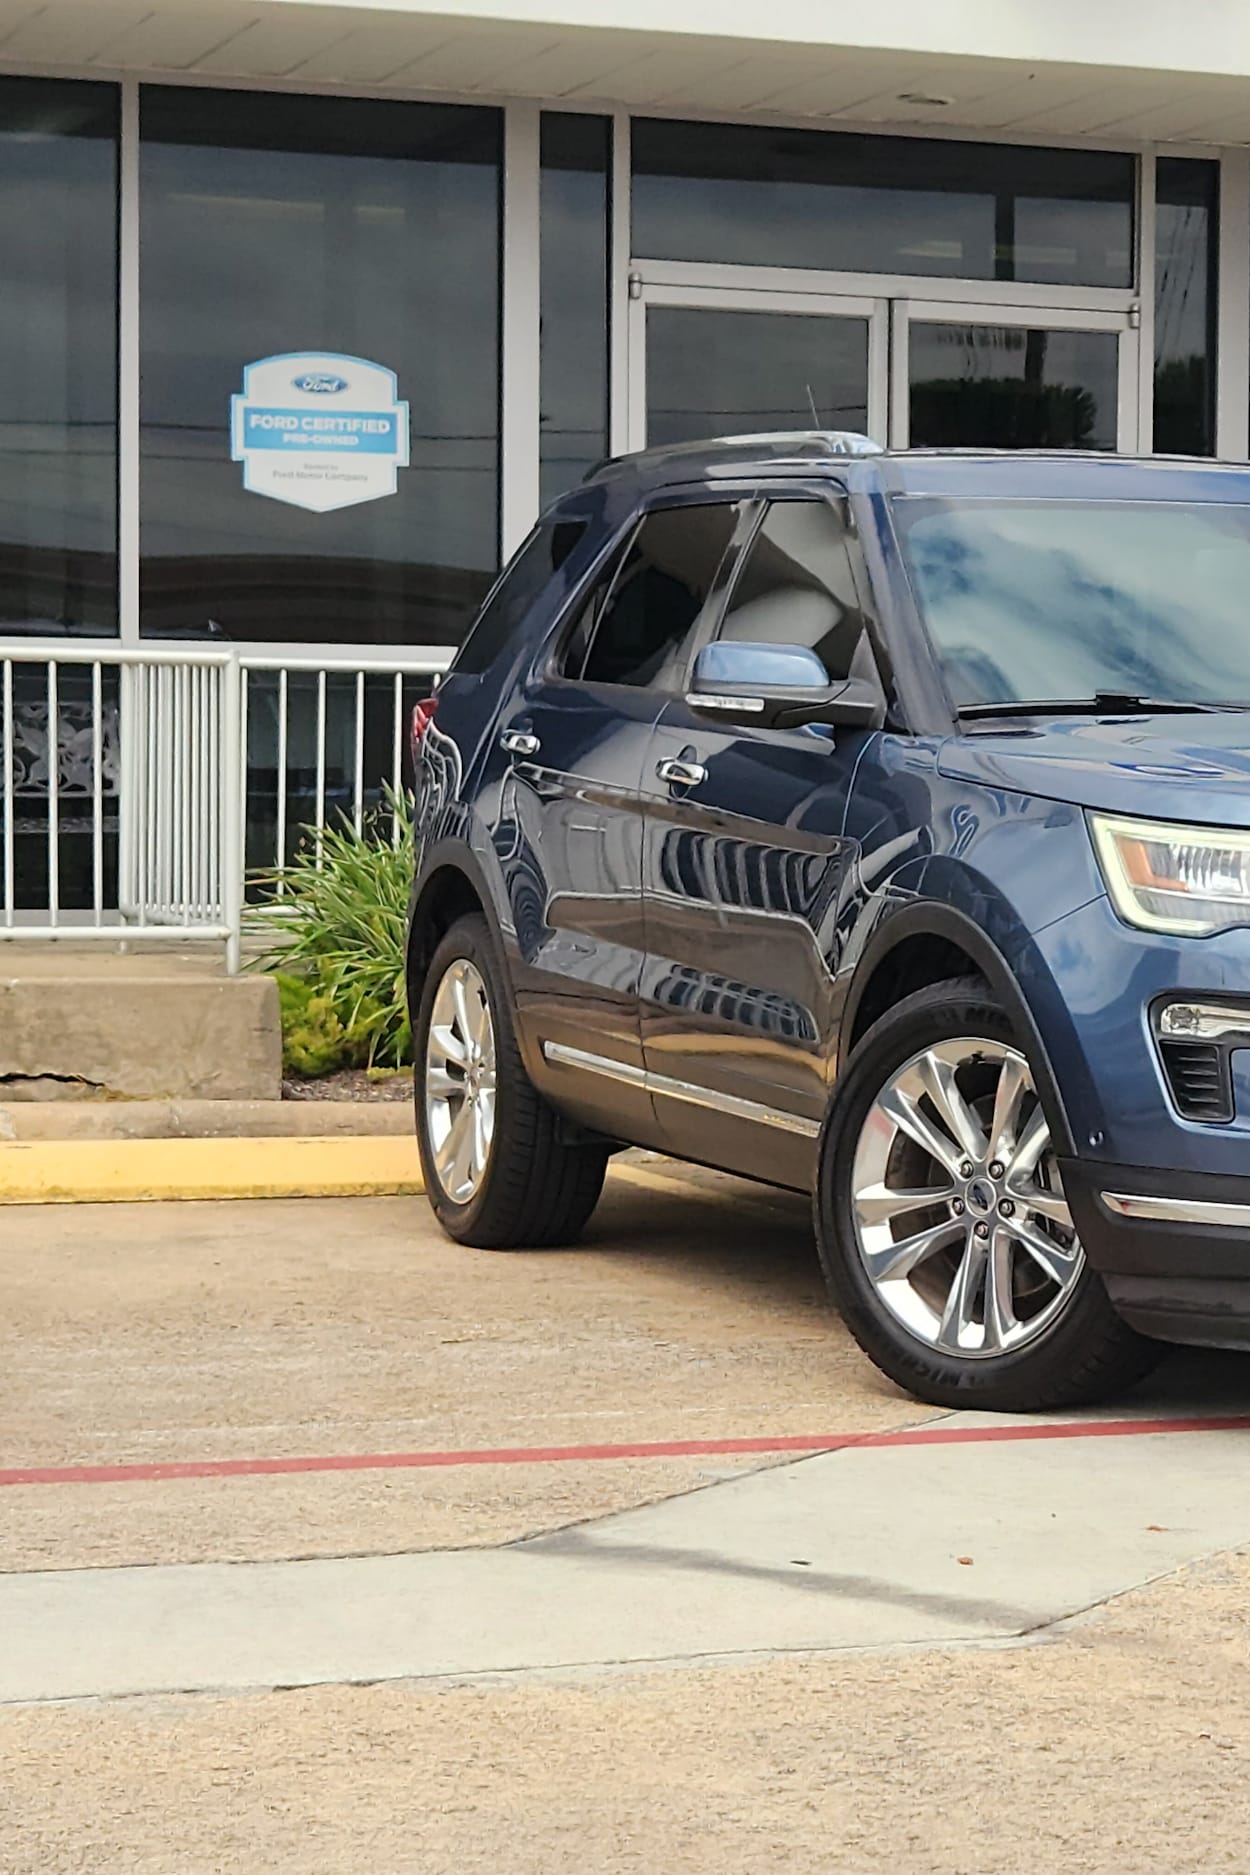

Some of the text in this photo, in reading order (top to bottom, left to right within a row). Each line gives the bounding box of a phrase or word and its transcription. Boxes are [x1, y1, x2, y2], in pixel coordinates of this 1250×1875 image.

[302, 376, 339, 391] Ford
[250, 414, 390, 433] FORD CERTIFIED
[283, 433, 358, 445] PRE-OWNED
